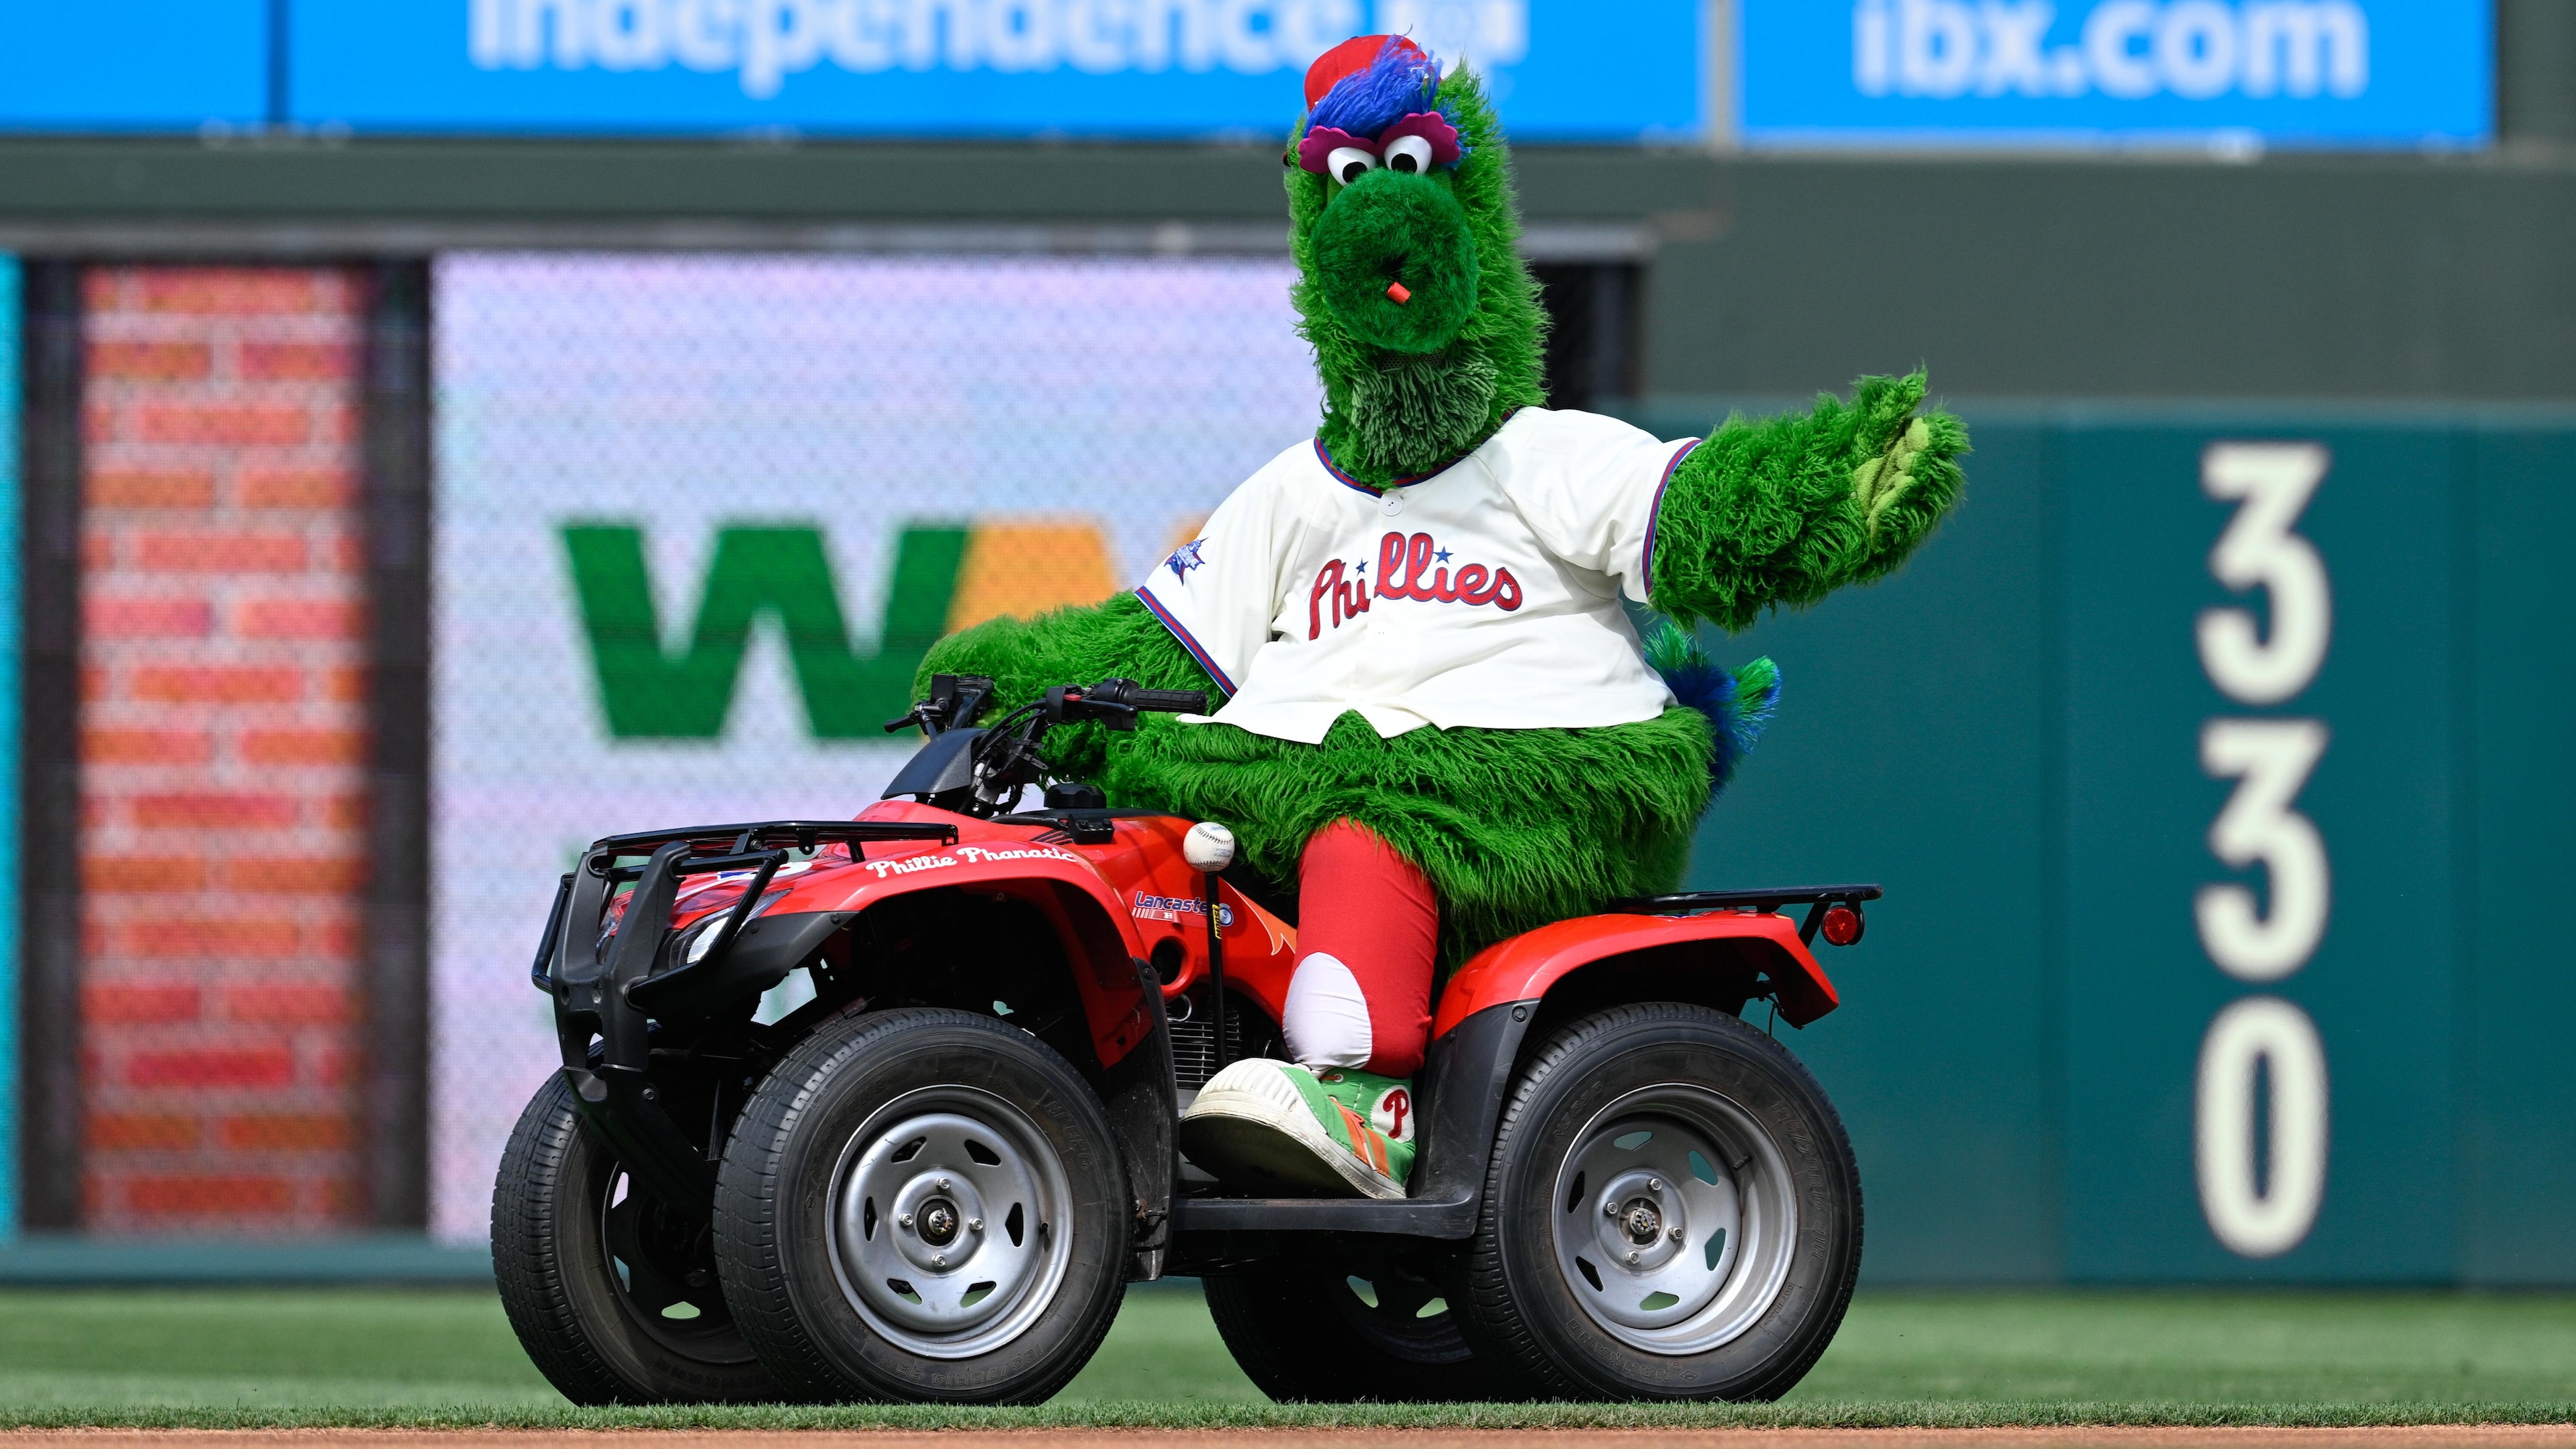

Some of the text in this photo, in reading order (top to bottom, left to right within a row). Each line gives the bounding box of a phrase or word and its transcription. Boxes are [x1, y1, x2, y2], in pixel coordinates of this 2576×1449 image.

[1308, 531, 1523, 640] Phillies
[866, 847, 1077, 878] Phillie Phanatic
[2191, 438, 2334, 1262] 330
[1134, 891, 1207, 914] Lancaste
[1213, 905, 1223, 940] MOOSE
[1382, 1089, 1410, 1139] P
